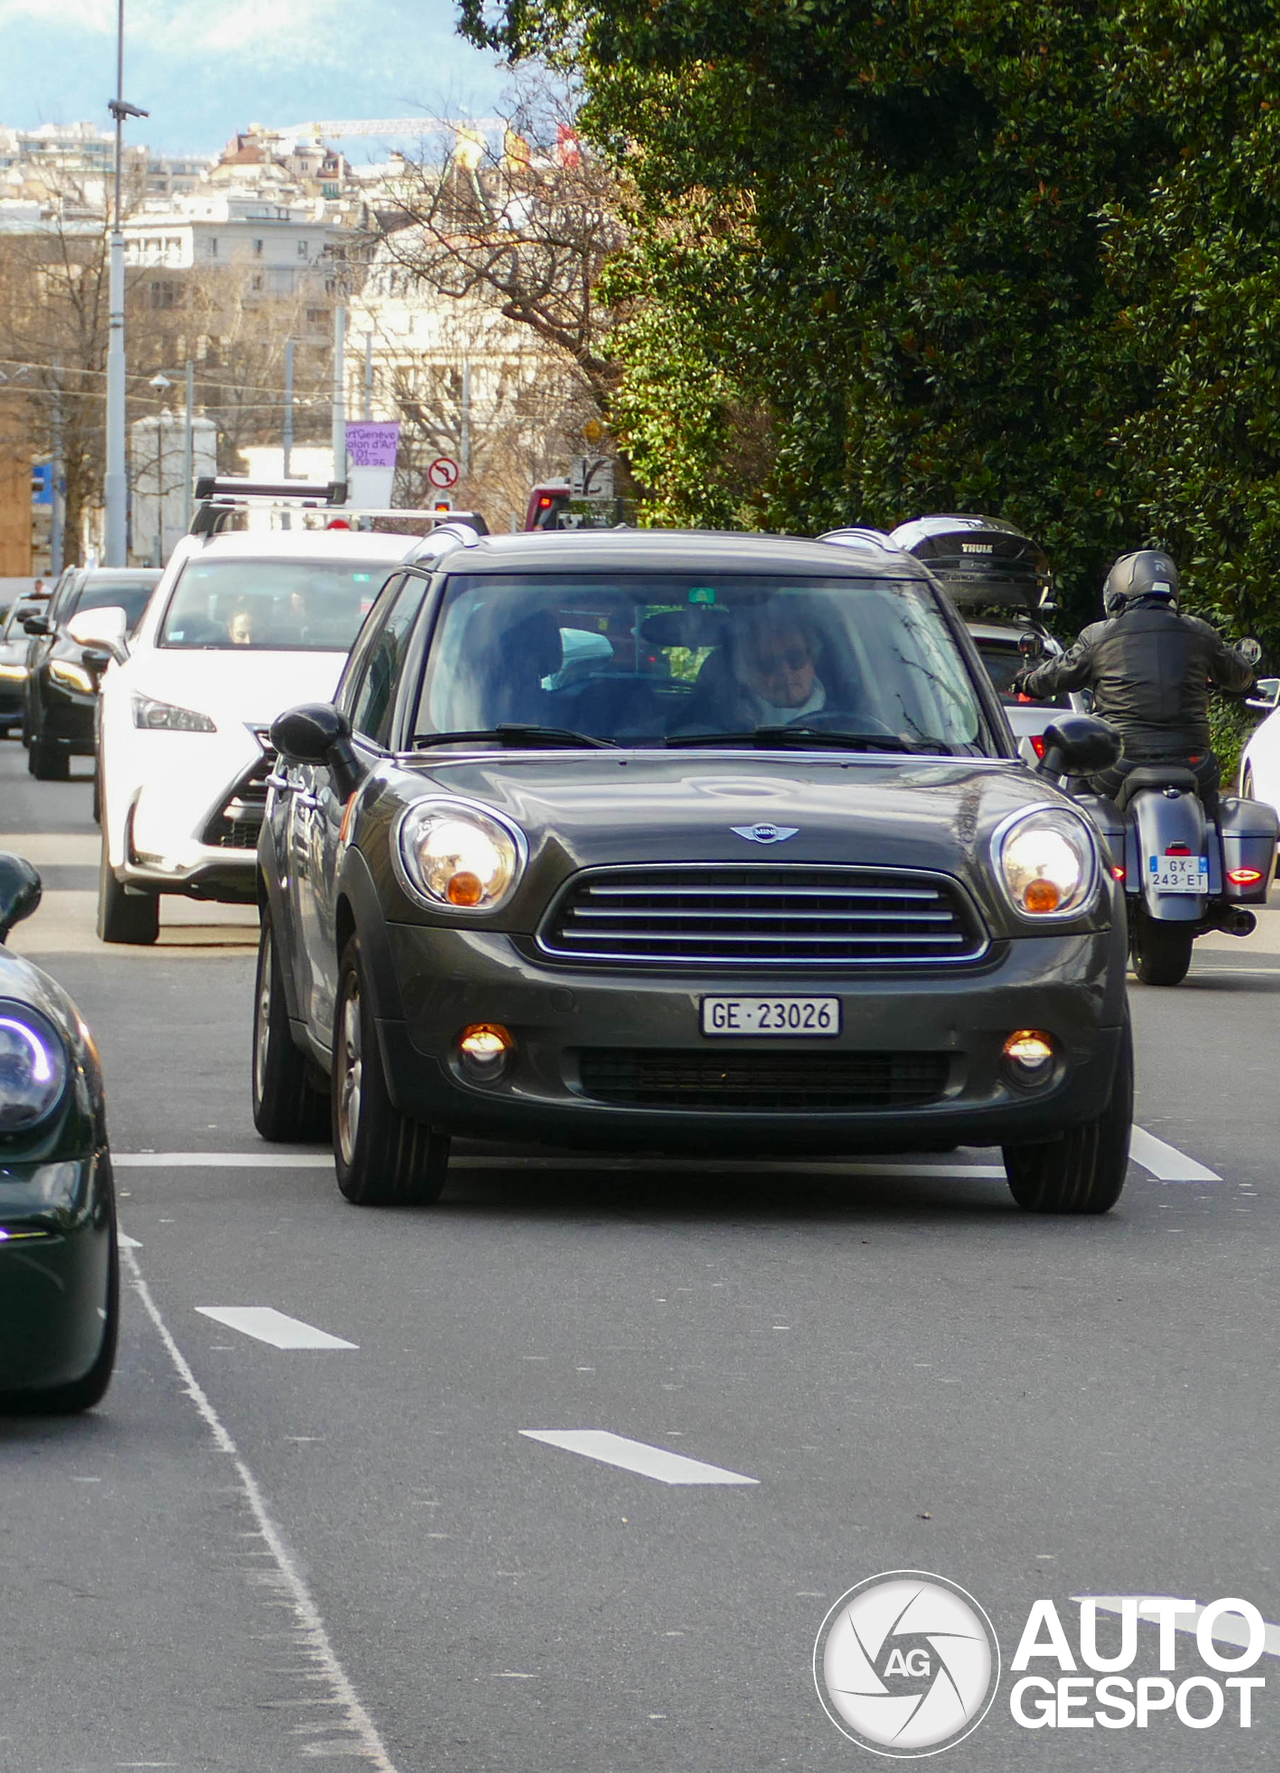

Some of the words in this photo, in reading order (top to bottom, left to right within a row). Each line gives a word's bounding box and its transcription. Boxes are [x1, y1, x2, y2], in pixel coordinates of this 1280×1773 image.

[346, 440, 370, 449] alon
[371, 440, 397, 450] d'Art
[962, 543, 993, 553] THULE
